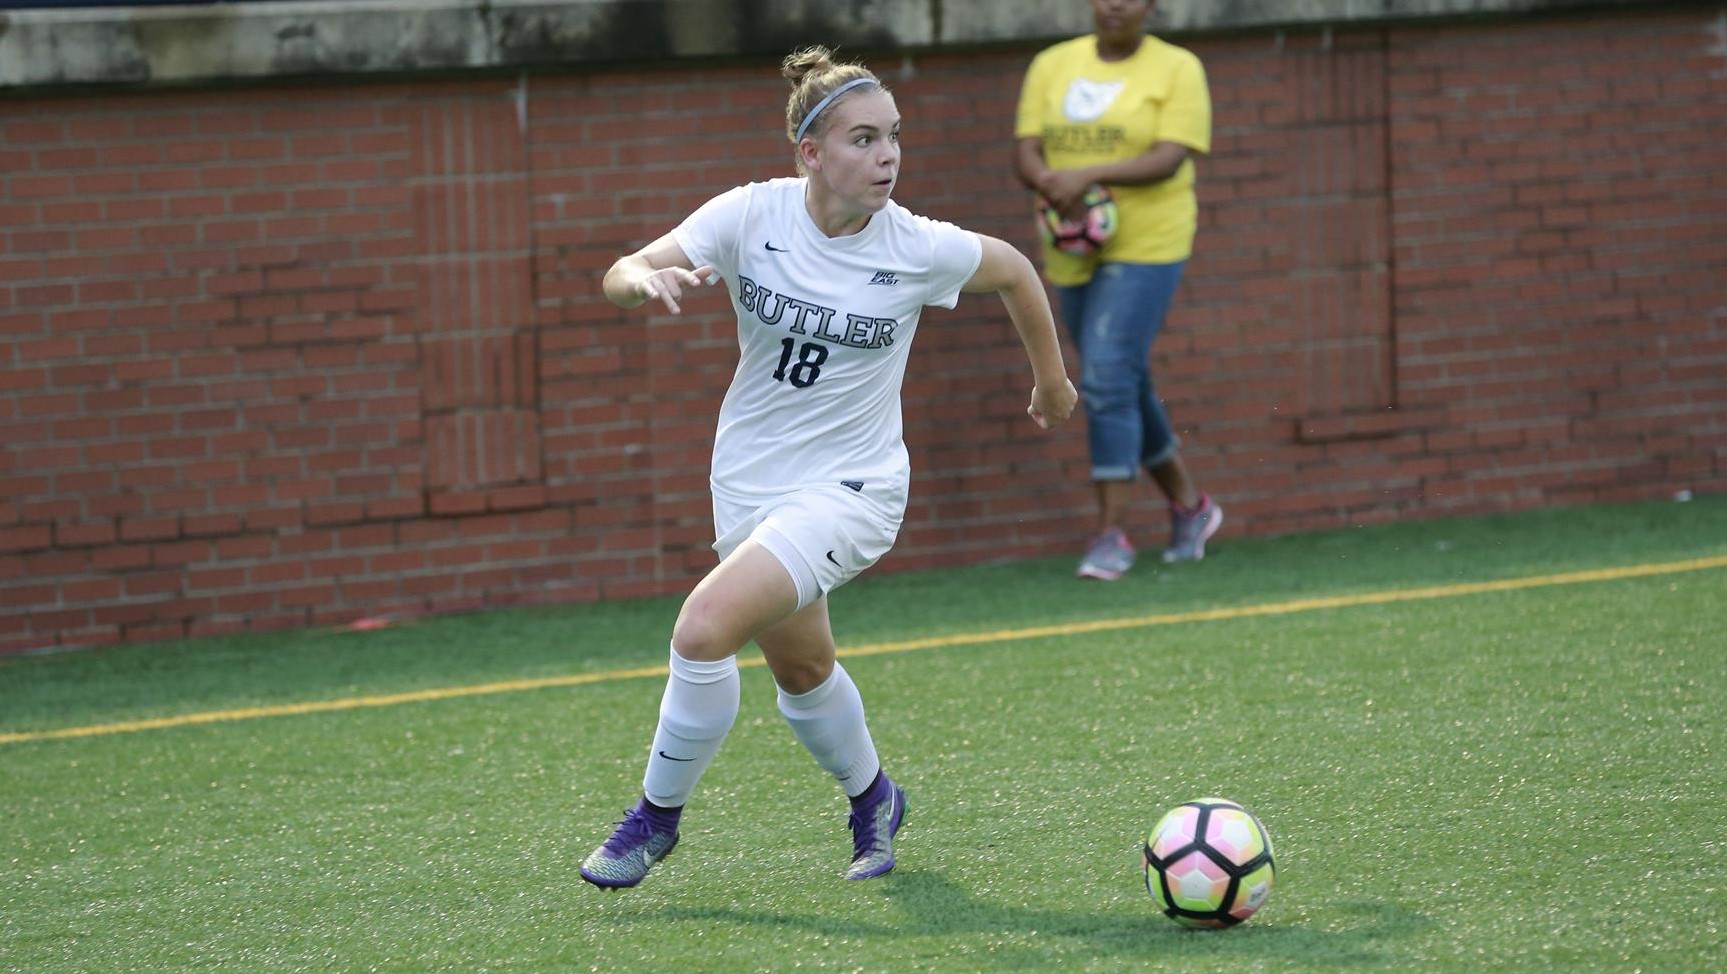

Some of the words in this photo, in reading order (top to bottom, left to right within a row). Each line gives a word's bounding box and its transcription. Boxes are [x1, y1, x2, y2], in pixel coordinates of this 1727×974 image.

[874, 271, 896, 279] BIG
[739, 275, 898, 349] BUTLER
[772, 337, 829, 388] 18
